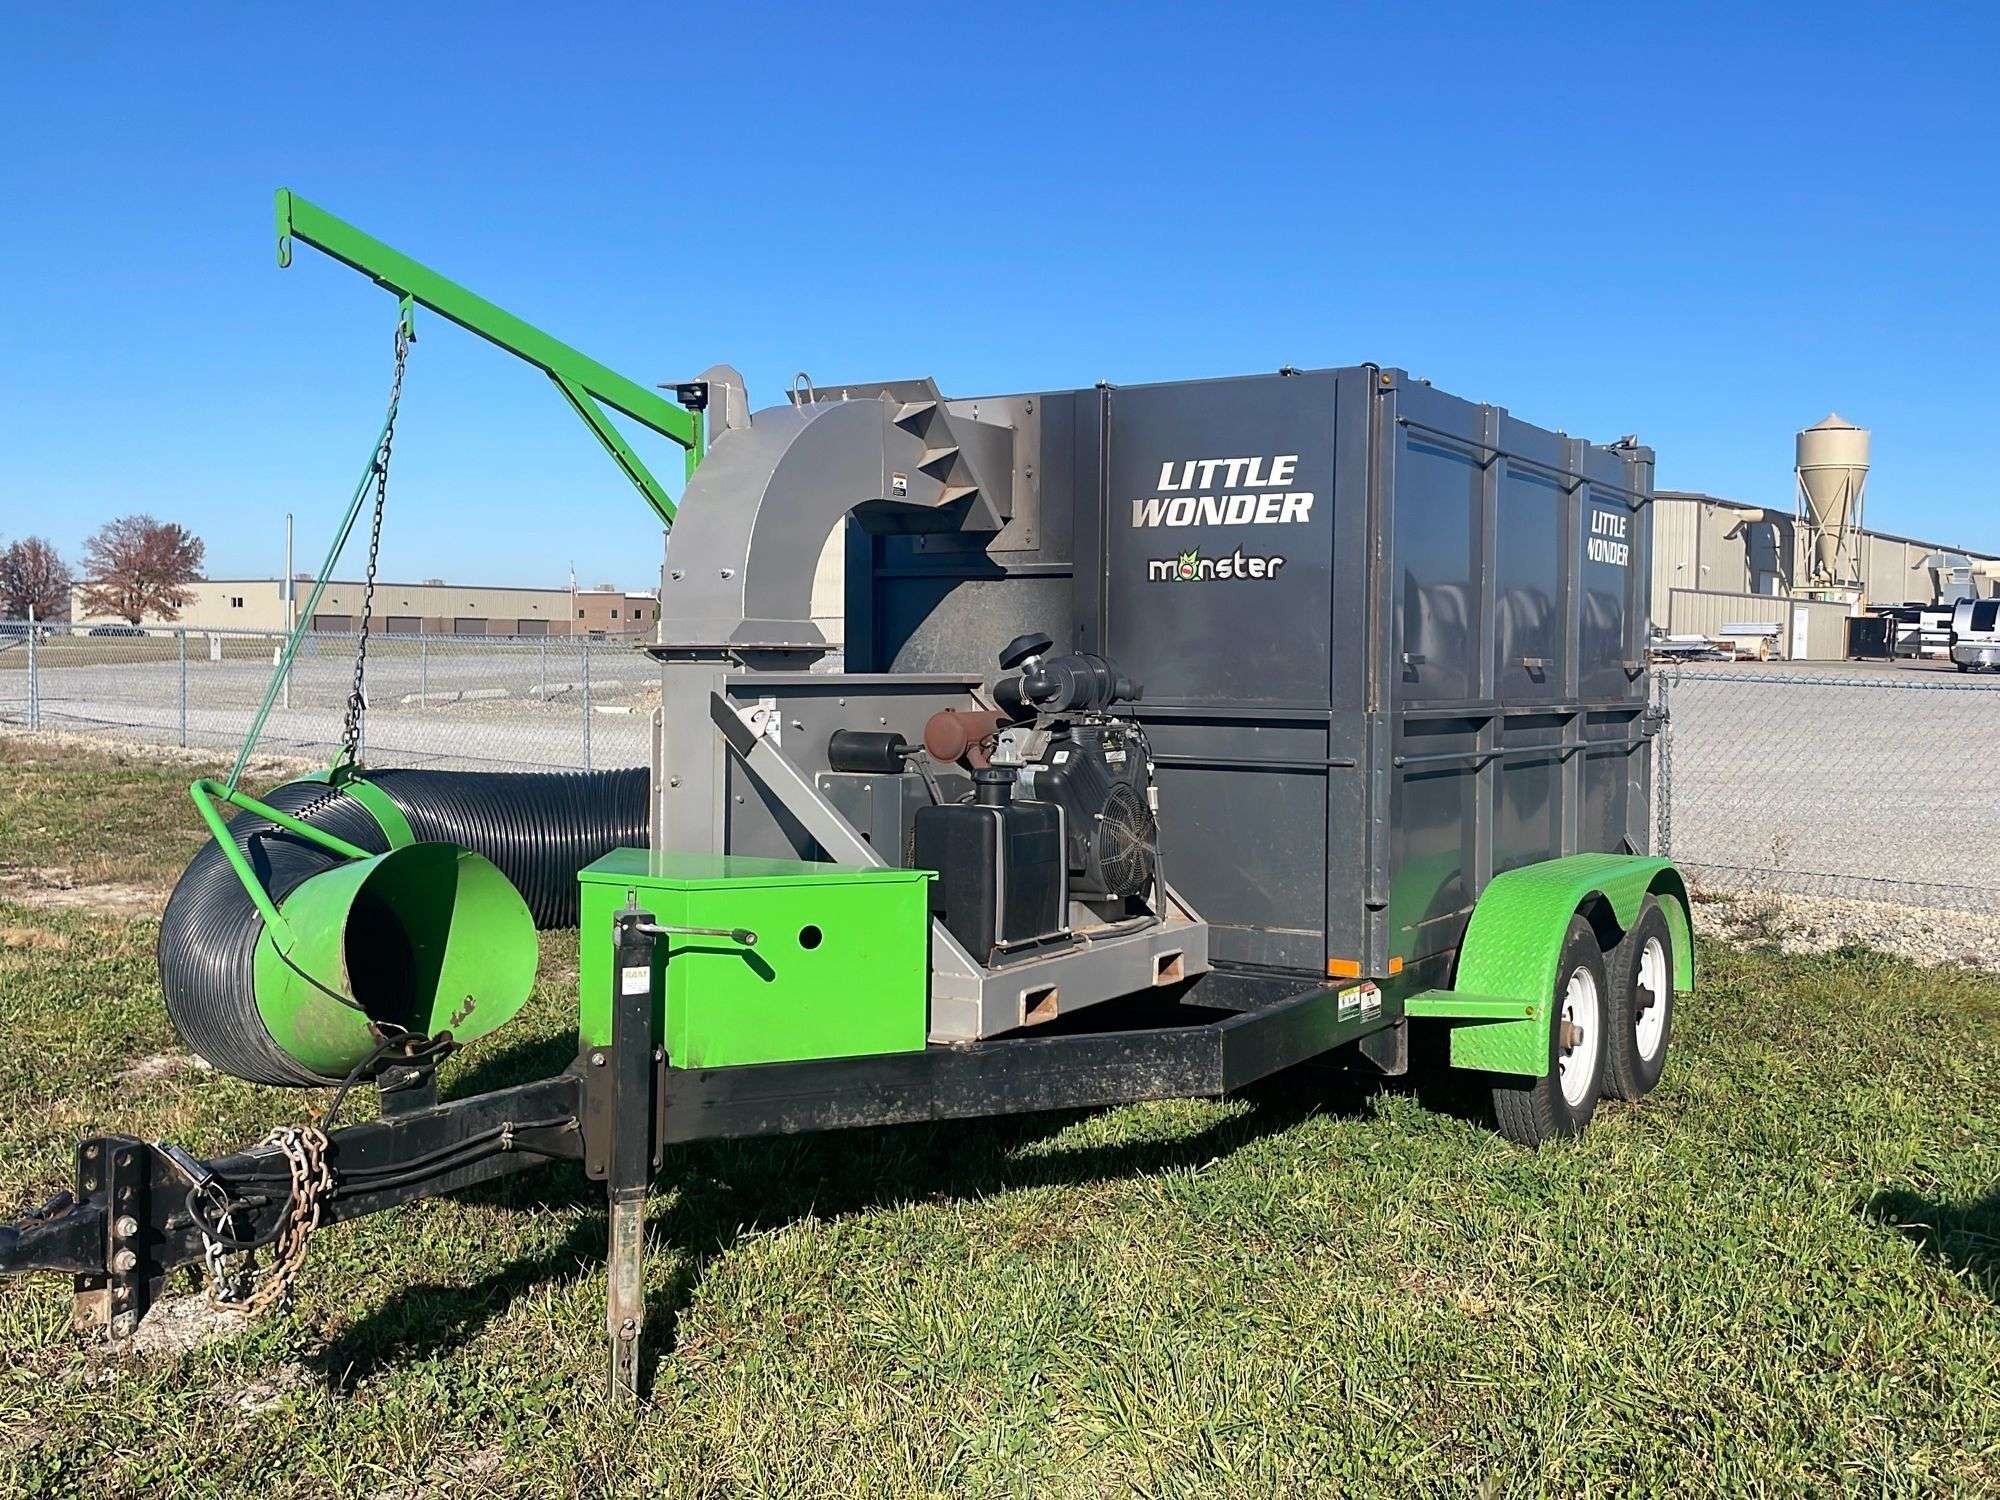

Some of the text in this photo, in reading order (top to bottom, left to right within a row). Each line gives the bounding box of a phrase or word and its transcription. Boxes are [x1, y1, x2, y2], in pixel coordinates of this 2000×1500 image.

[1156, 454, 1299, 491] LITTLE
[1131, 491, 1315, 528] WONDER
[1591, 509, 1627, 539] LITTLE
